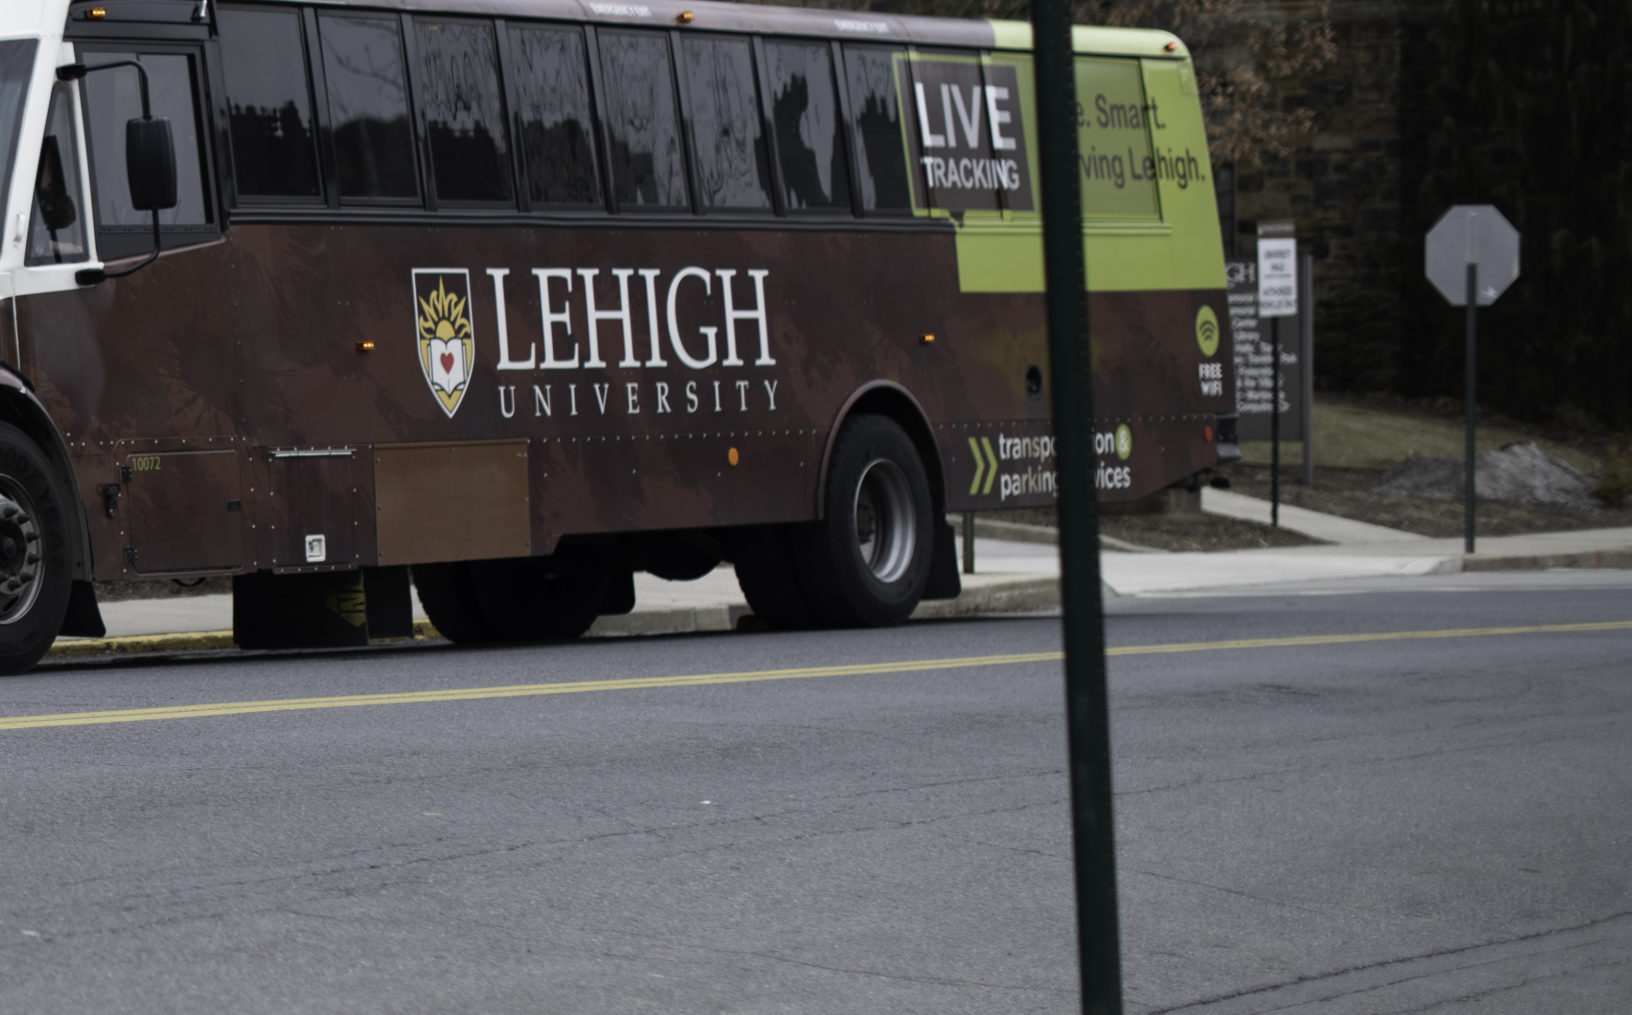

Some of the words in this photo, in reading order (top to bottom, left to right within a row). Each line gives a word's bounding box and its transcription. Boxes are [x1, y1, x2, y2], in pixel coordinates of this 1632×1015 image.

[914, 82, 1017, 151] LIVE
[1095, 94, 1166, 129] Smart.
[921, 156, 1020, 191] TRACKING
[1128, 146, 1206, 190] Lehigh.
[485, 266, 777, 370] LEHIGH
[1199, 363, 1223, 379] FREE
[1201, 381, 1223, 396] WIFI
[498, 379, 778, 418] UNIVERSITY
[131, 456, 161, 472] 10072
